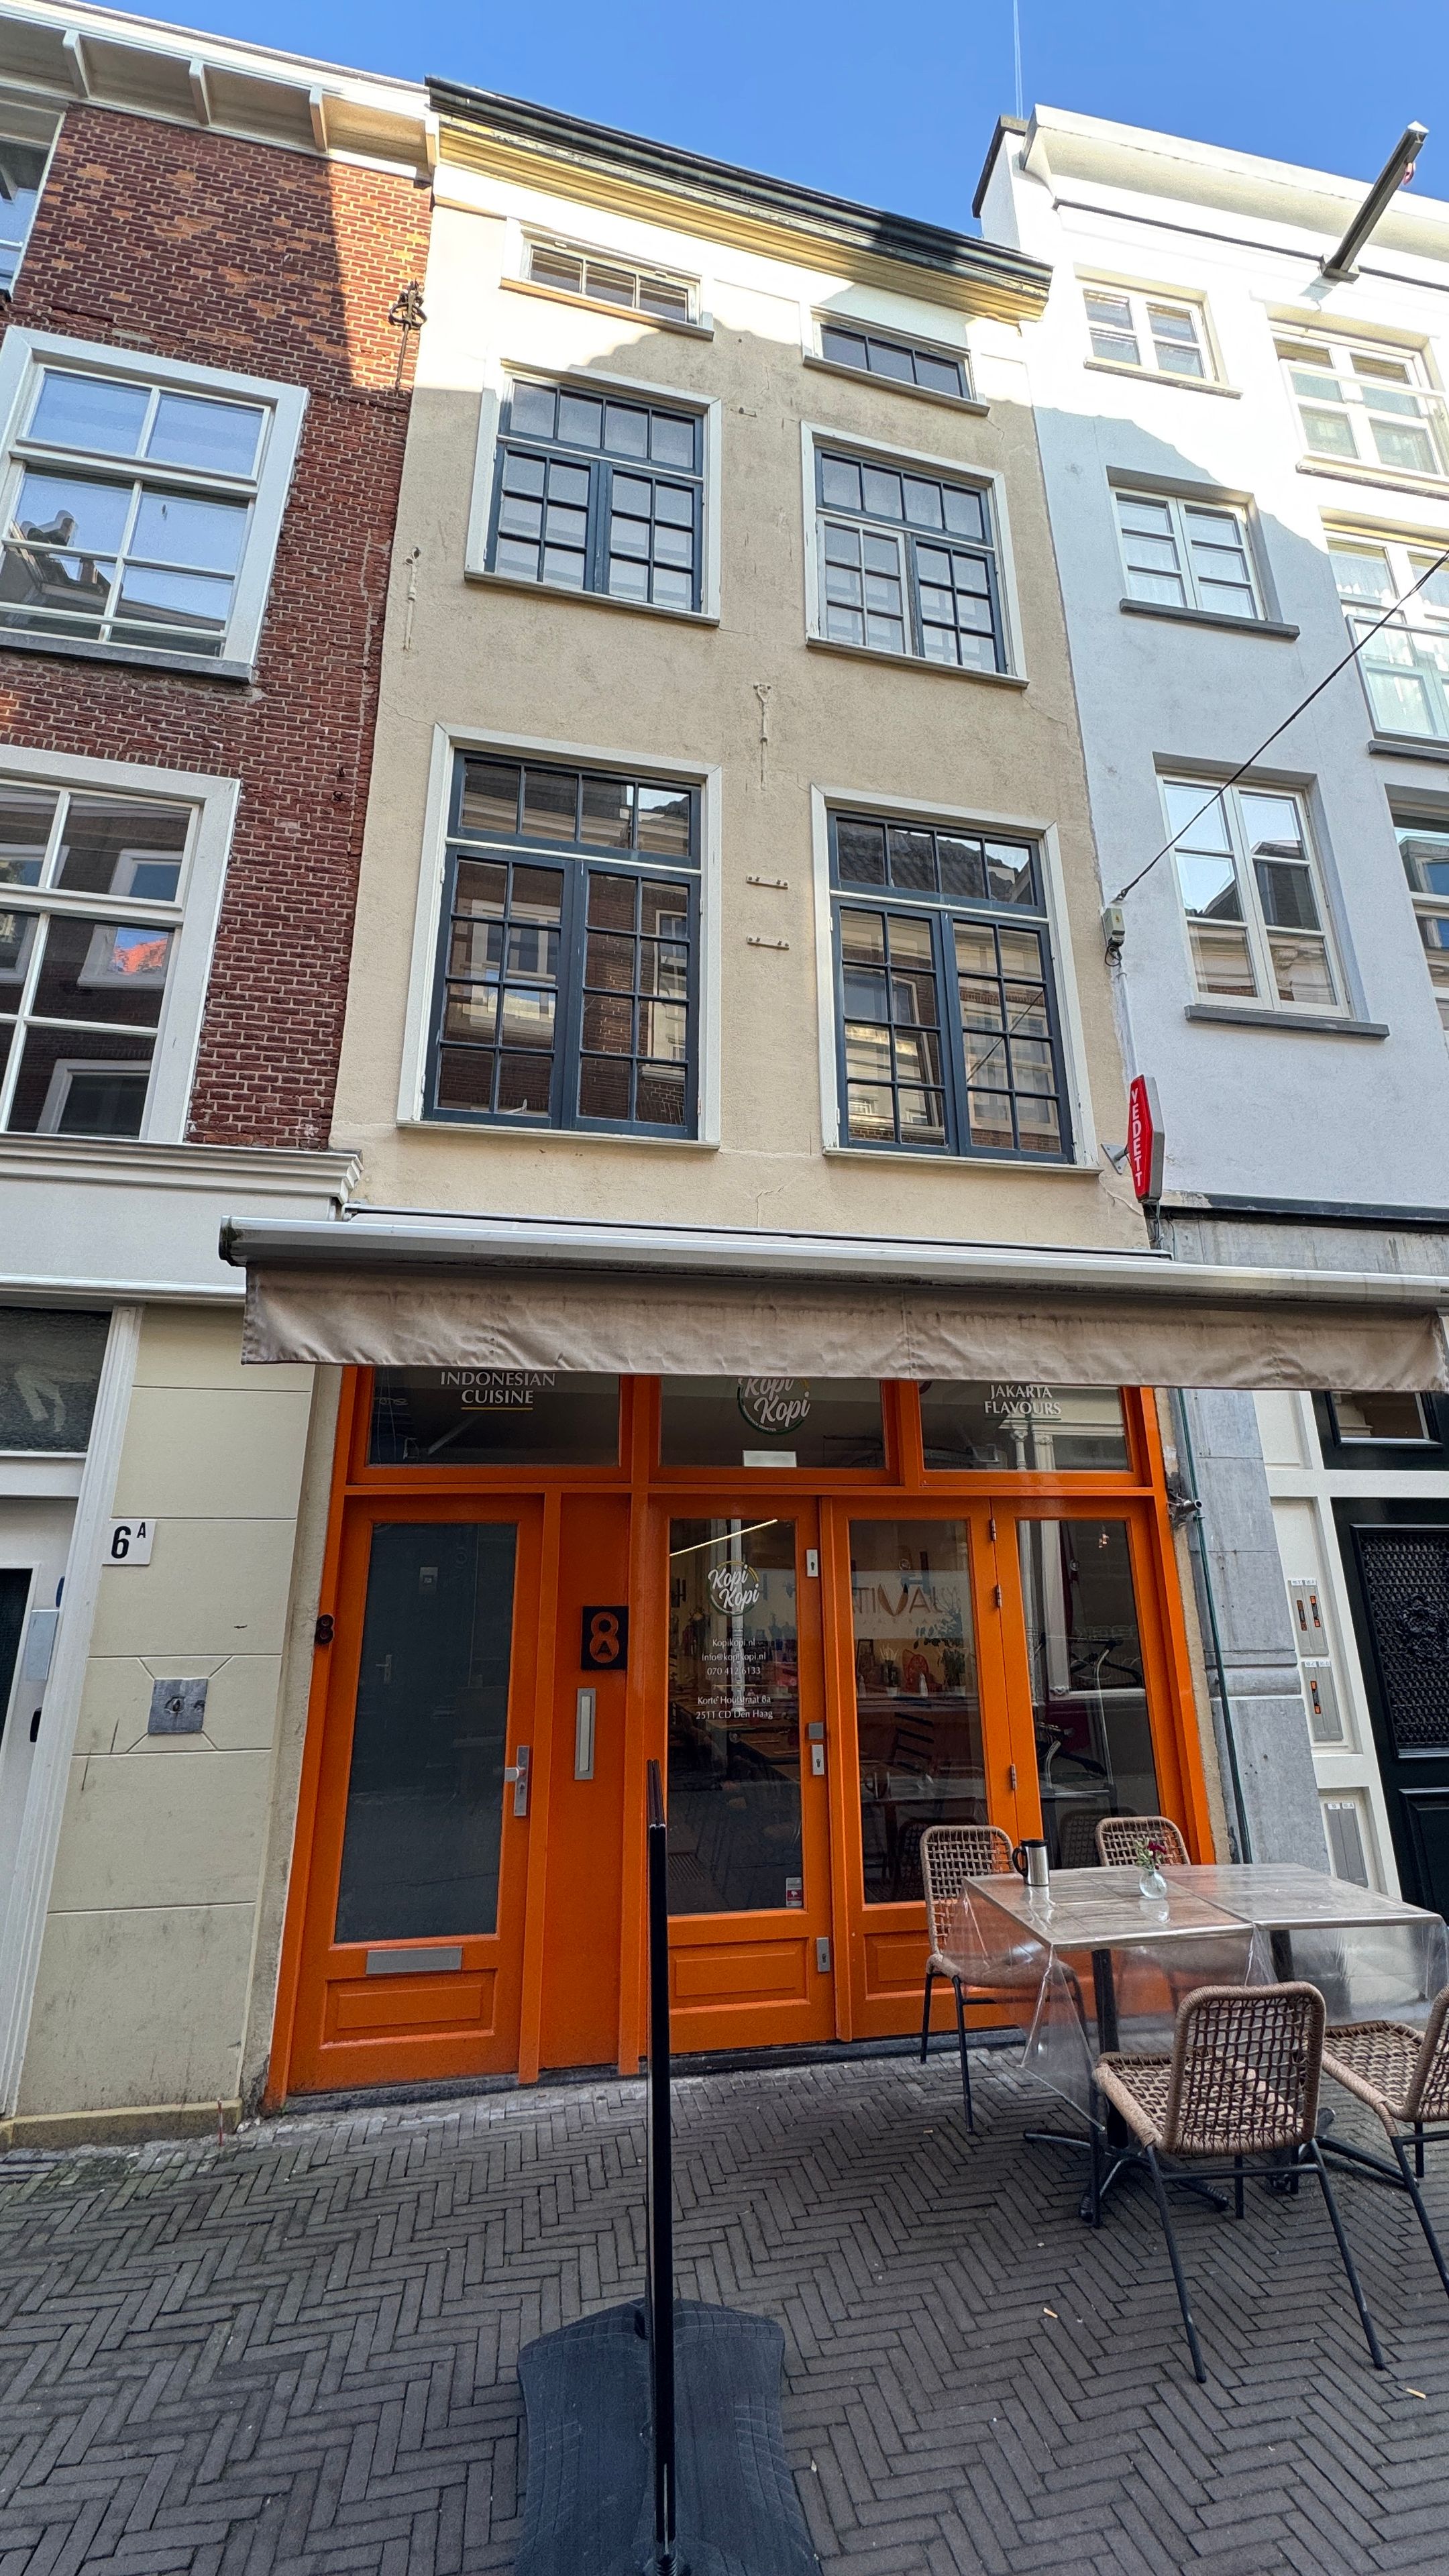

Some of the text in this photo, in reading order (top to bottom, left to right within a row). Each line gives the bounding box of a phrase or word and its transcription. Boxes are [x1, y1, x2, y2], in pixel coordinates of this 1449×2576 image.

[1131, 1088, 1142, 1187] VEDETT
[440, 1371, 555, 1387] INDONESIAN
[462, 1389, 534, 1403] CUISINE
[990, 1385, 1053, 1399] JAKARTA
[753, 1395, 810, 1428] Kopi
[984, 1401, 1062, 1415] FLAVOURS
[708, 1564, 749, 1592] Kopi
[718, 1583, 759, 1611] Kopi
[712, 1638, 755, 1649] Kopikopi.nl
[741, 1667, 761, 1675] 6133
[698, 1696, 718, 1705] Korte
[761, 1696, 771, 1704] 8a
[696, 1709, 773, 1719] 2511 CD Den Haag
